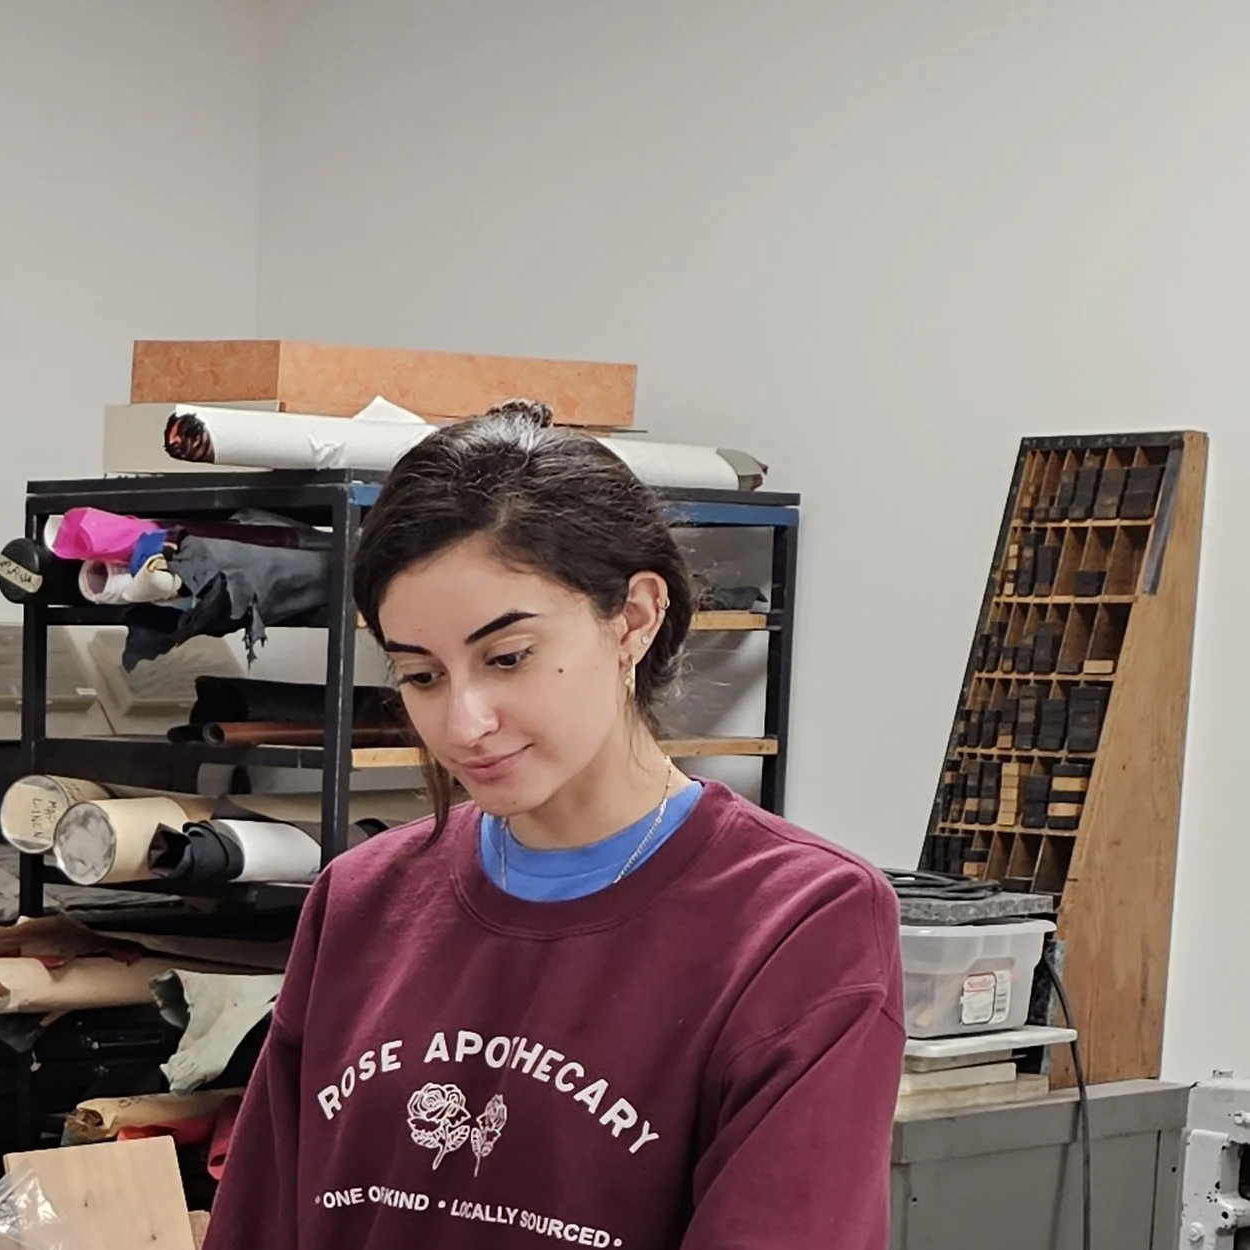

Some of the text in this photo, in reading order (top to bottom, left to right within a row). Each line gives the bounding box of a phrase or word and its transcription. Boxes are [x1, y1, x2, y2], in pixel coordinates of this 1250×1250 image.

[317, 1039, 403, 1121] ROSE
[323, 1187, 366, 1209] ONE
[383, 1188, 430, 1211] KIND
[450, 1199, 610, 1249] LOCALLY SOURCED
